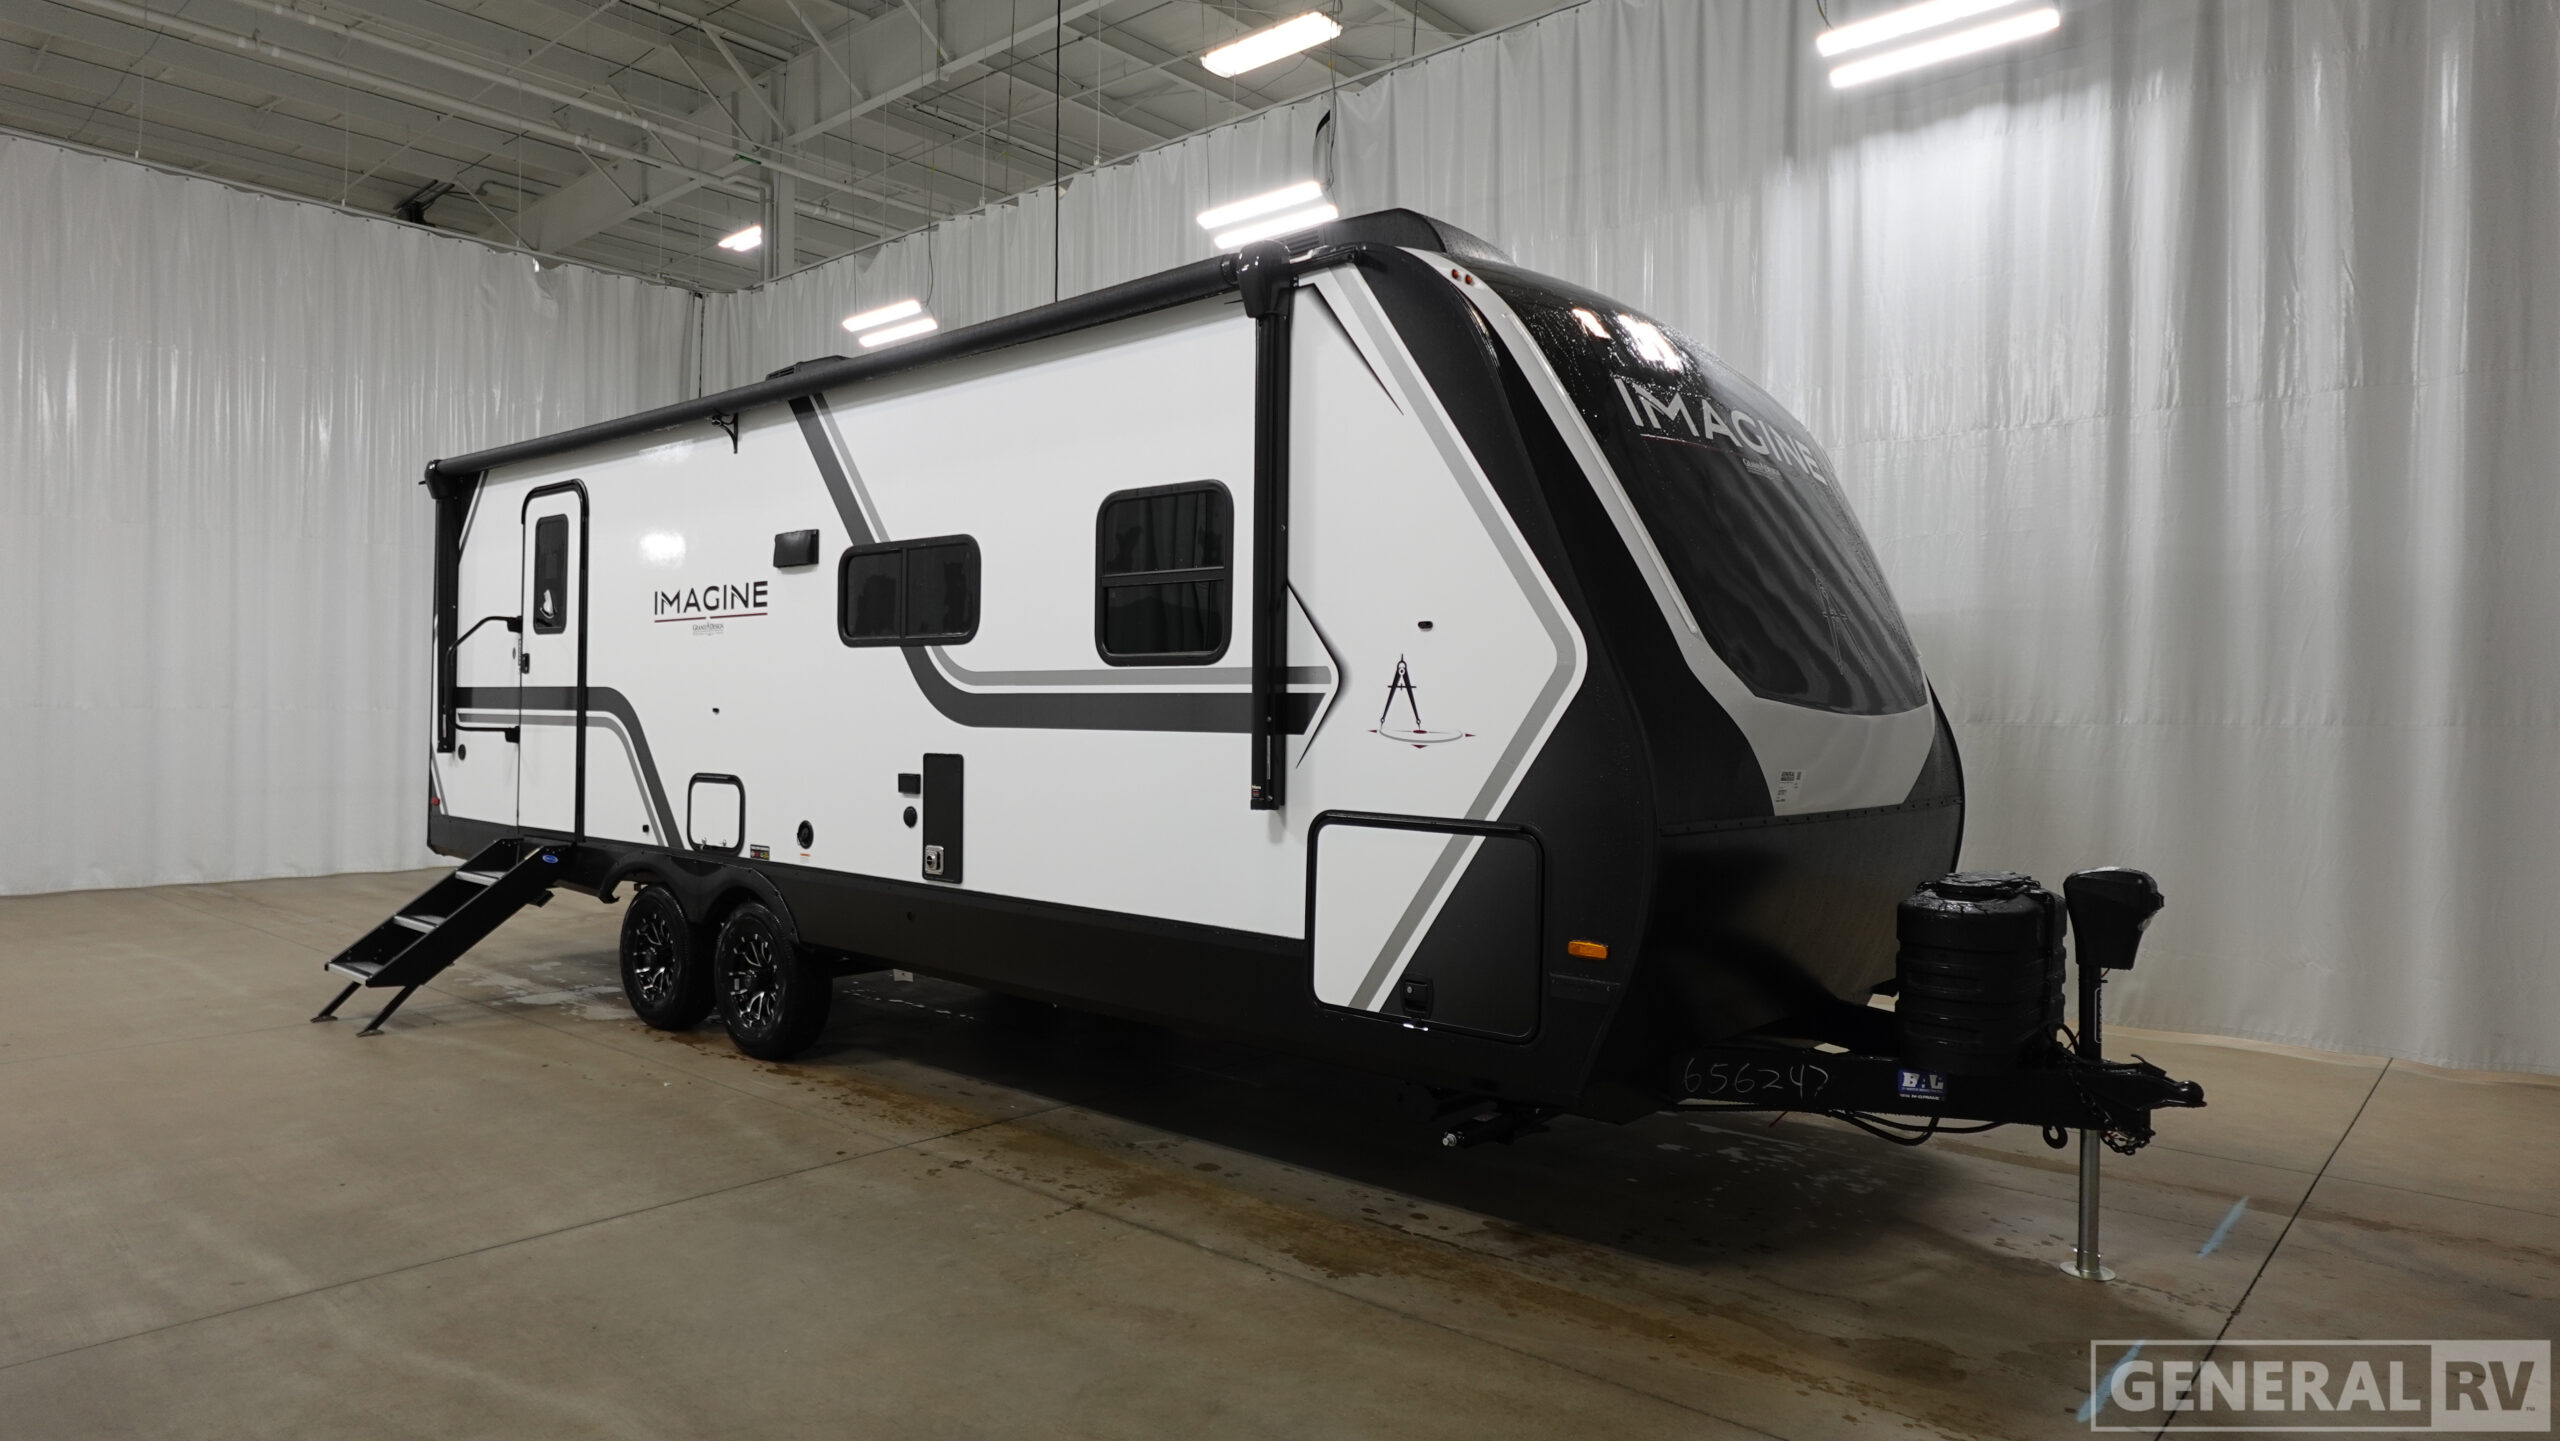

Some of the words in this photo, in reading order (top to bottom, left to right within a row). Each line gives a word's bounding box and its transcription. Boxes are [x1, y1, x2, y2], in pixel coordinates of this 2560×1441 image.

[1613, 377, 1829, 487] IMAGINE
[654, 580, 768, 615] IMAGINE
[1684, 1057, 1829, 1099] 656247
